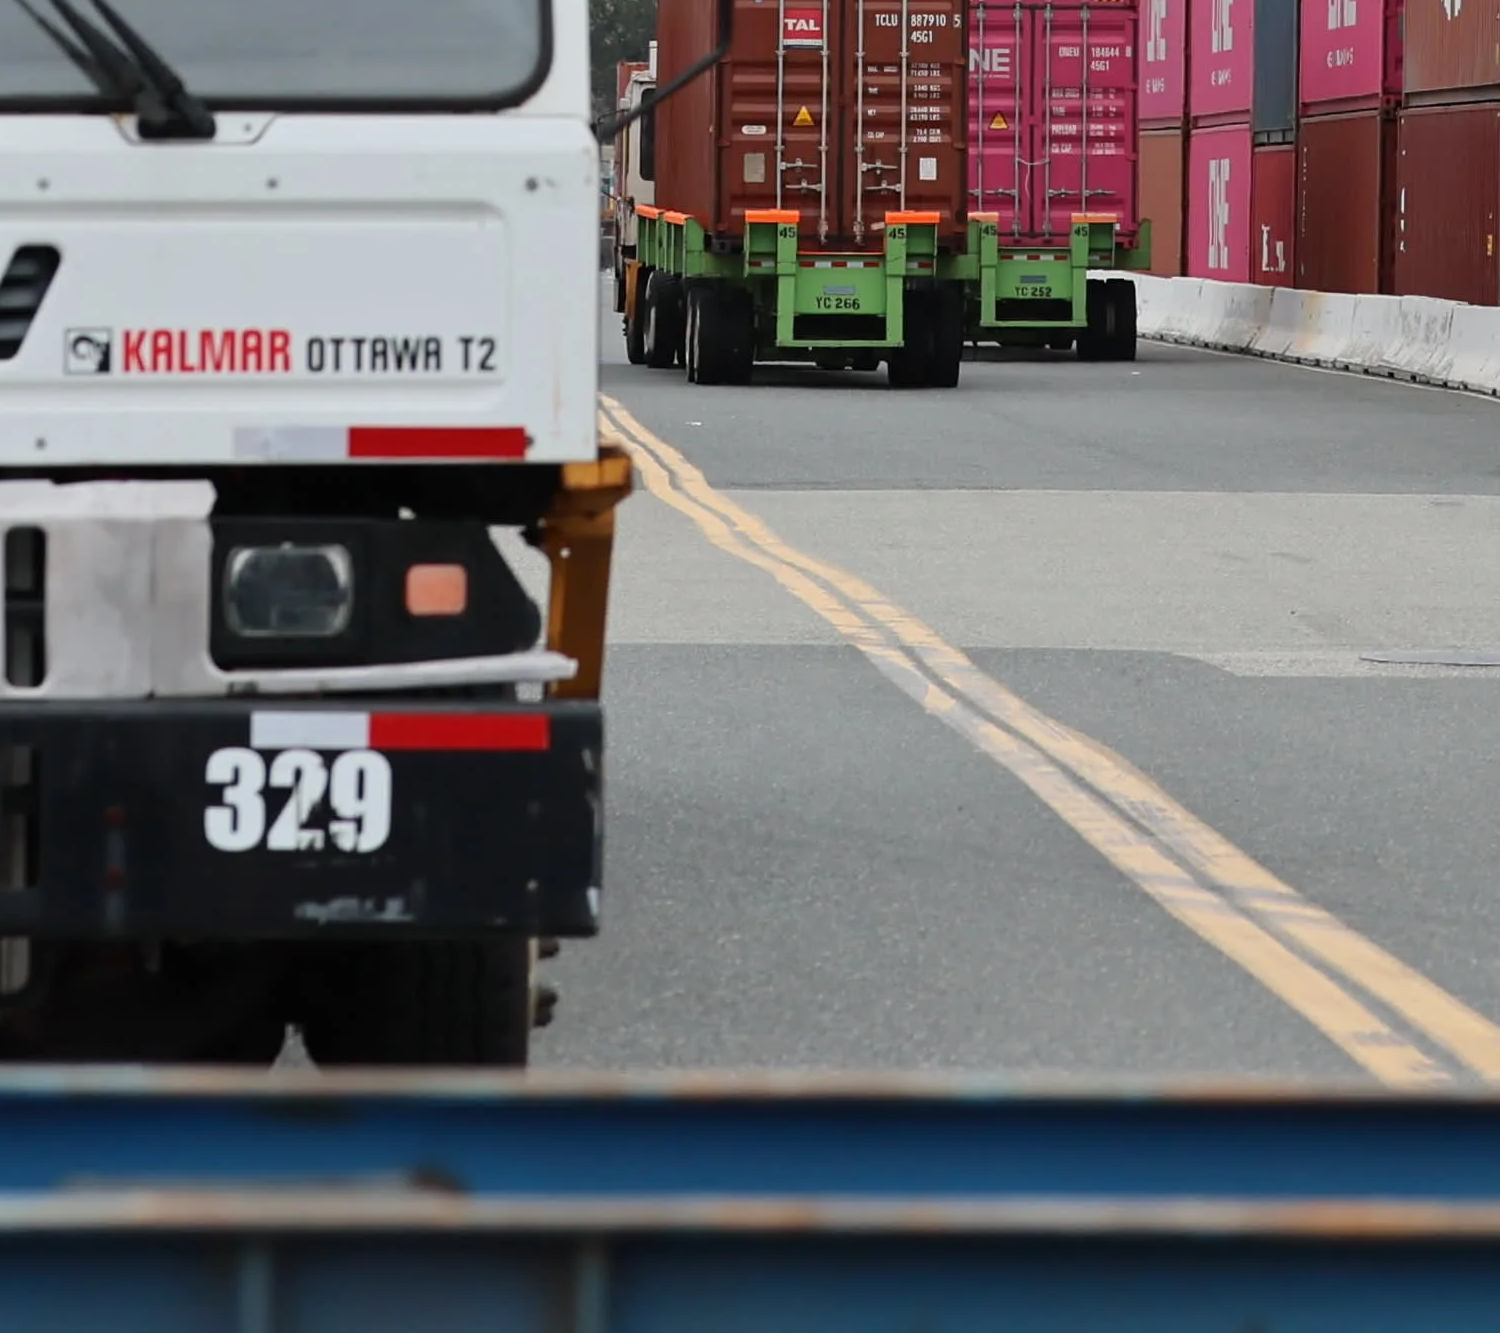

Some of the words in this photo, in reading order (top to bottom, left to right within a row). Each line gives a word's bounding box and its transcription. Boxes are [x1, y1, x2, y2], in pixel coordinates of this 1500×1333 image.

[784, 18, 820, 31] TAL
[875, 14, 898, 26] TCLU
[910, 14, 947, 27] 887910
[910, 31, 933, 43] 45G1
[969, 48, 1010, 72] NE
[779, 226, 796, 239] 45
[888, 227, 905, 240] 45
[983, 225, 997, 236] 45
[1074, 226, 1088, 237] 45
[1015, 287, 1029, 297] YC
[1031, 287, 1052, 297] 252
[816, 297, 832, 310] YC
[835, 297, 860, 311] 266
[122, 329, 292, 374] KALMAR
[306, 336, 442, 373] OTTAWA
[459, 336, 497, 373] T2
[204, 746, 392, 853] 329
